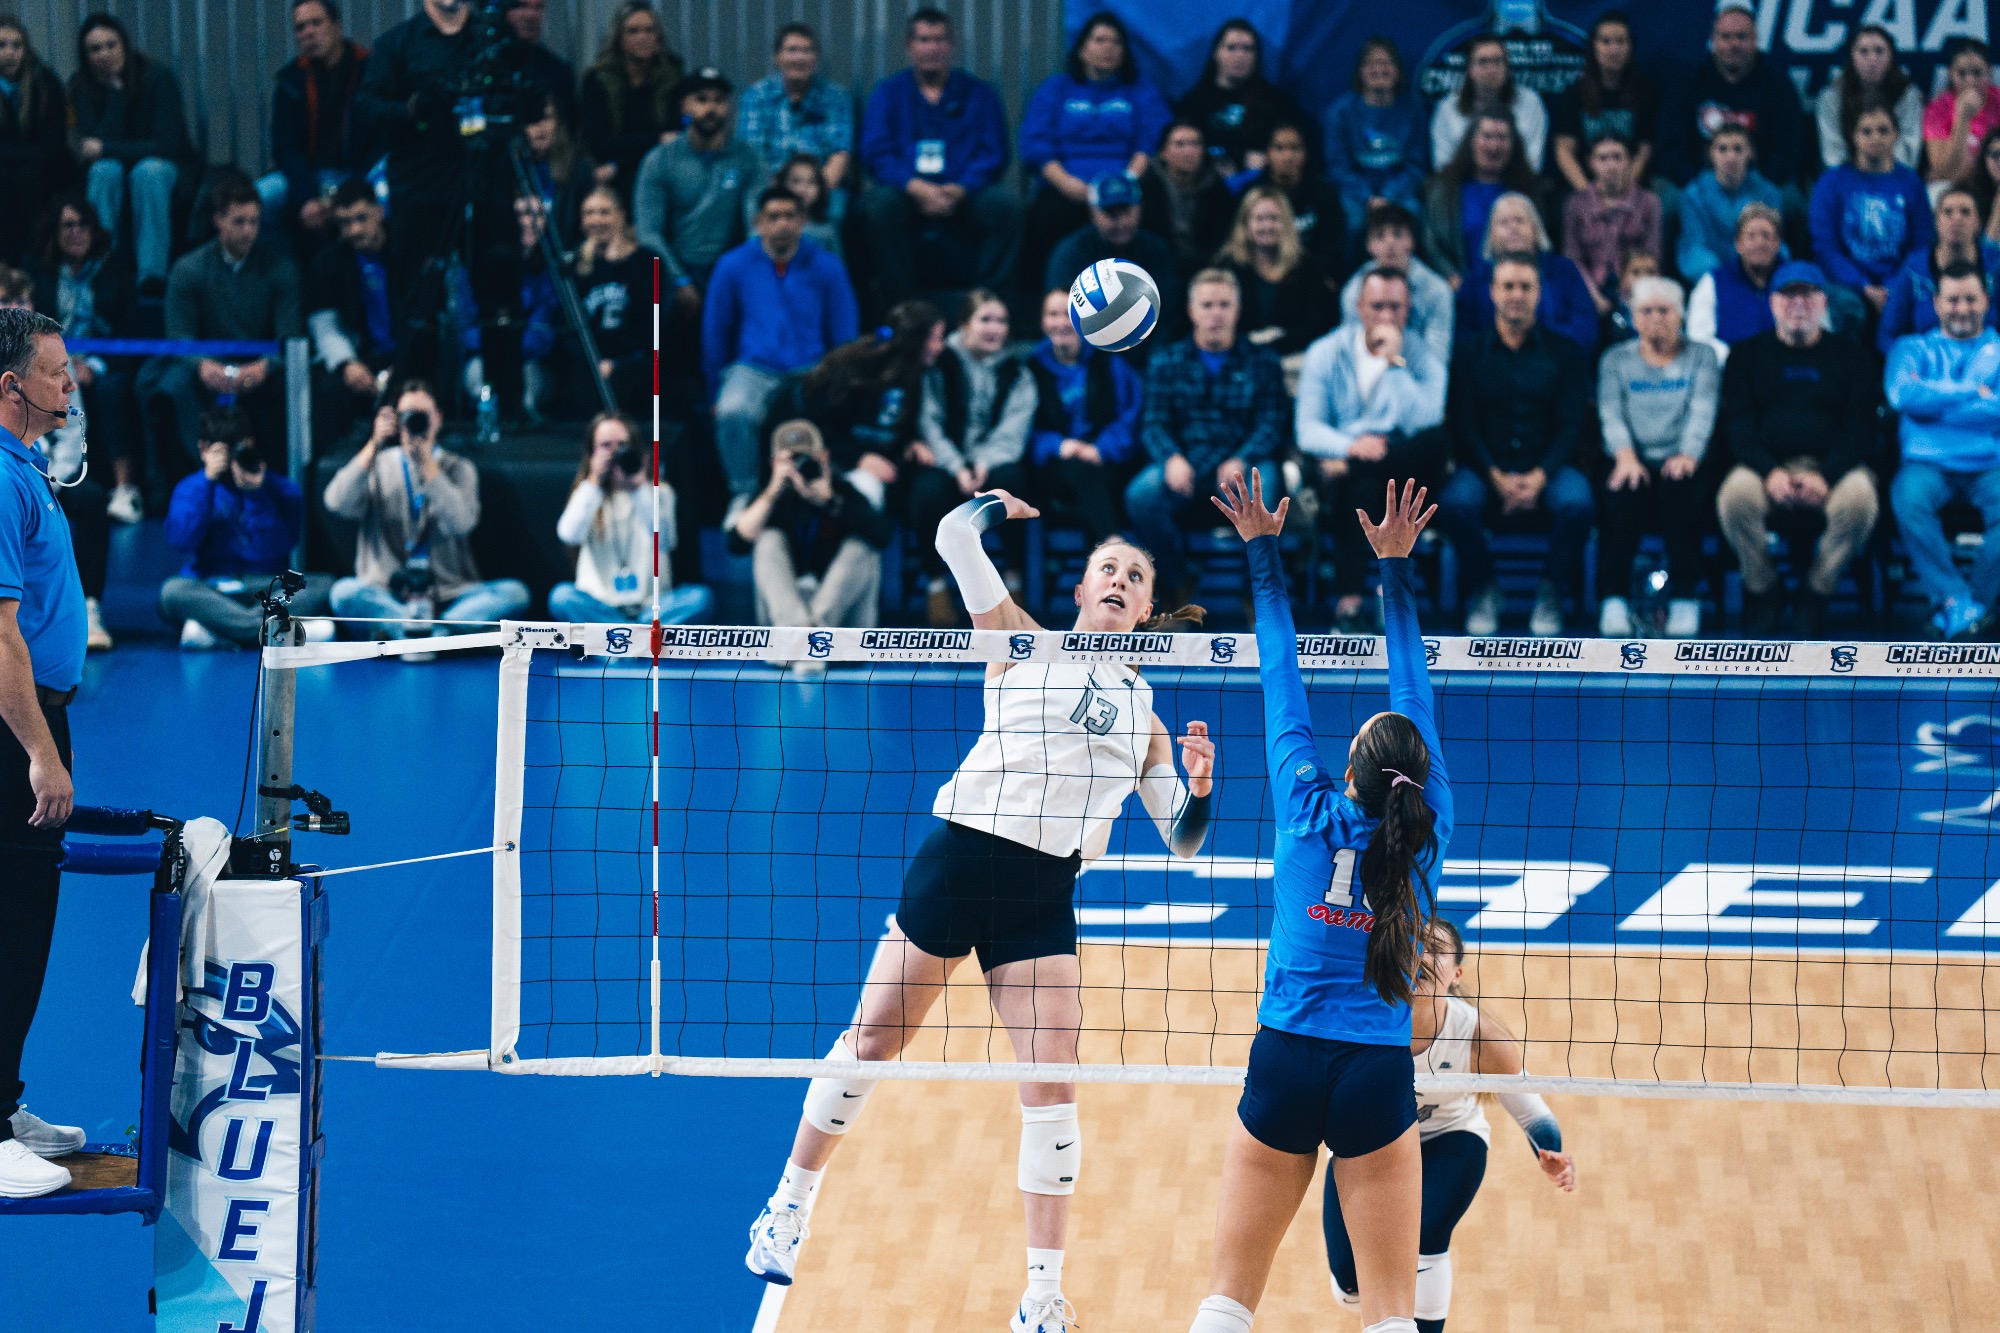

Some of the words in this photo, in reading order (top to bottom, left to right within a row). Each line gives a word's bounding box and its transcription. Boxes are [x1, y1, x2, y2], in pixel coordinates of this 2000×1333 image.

[661, 628, 770, 647] CREIGHTON
[861, 631, 971, 649] CREIGHTON
[1062, 634, 1173, 652] CREIGHTON
[1297, 637, 1375, 656] IGHTON
[1468, 640, 1581, 659] CREIGHTON
[1675, 643, 1791, 662] CREIGHTON
[1886, 645, 2000, 664] CREIGHTON
[1069, 685, 1119, 737] 13
[1323, 848, 1374, 912] 1
[1306, 903, 1346, 927] Ole
